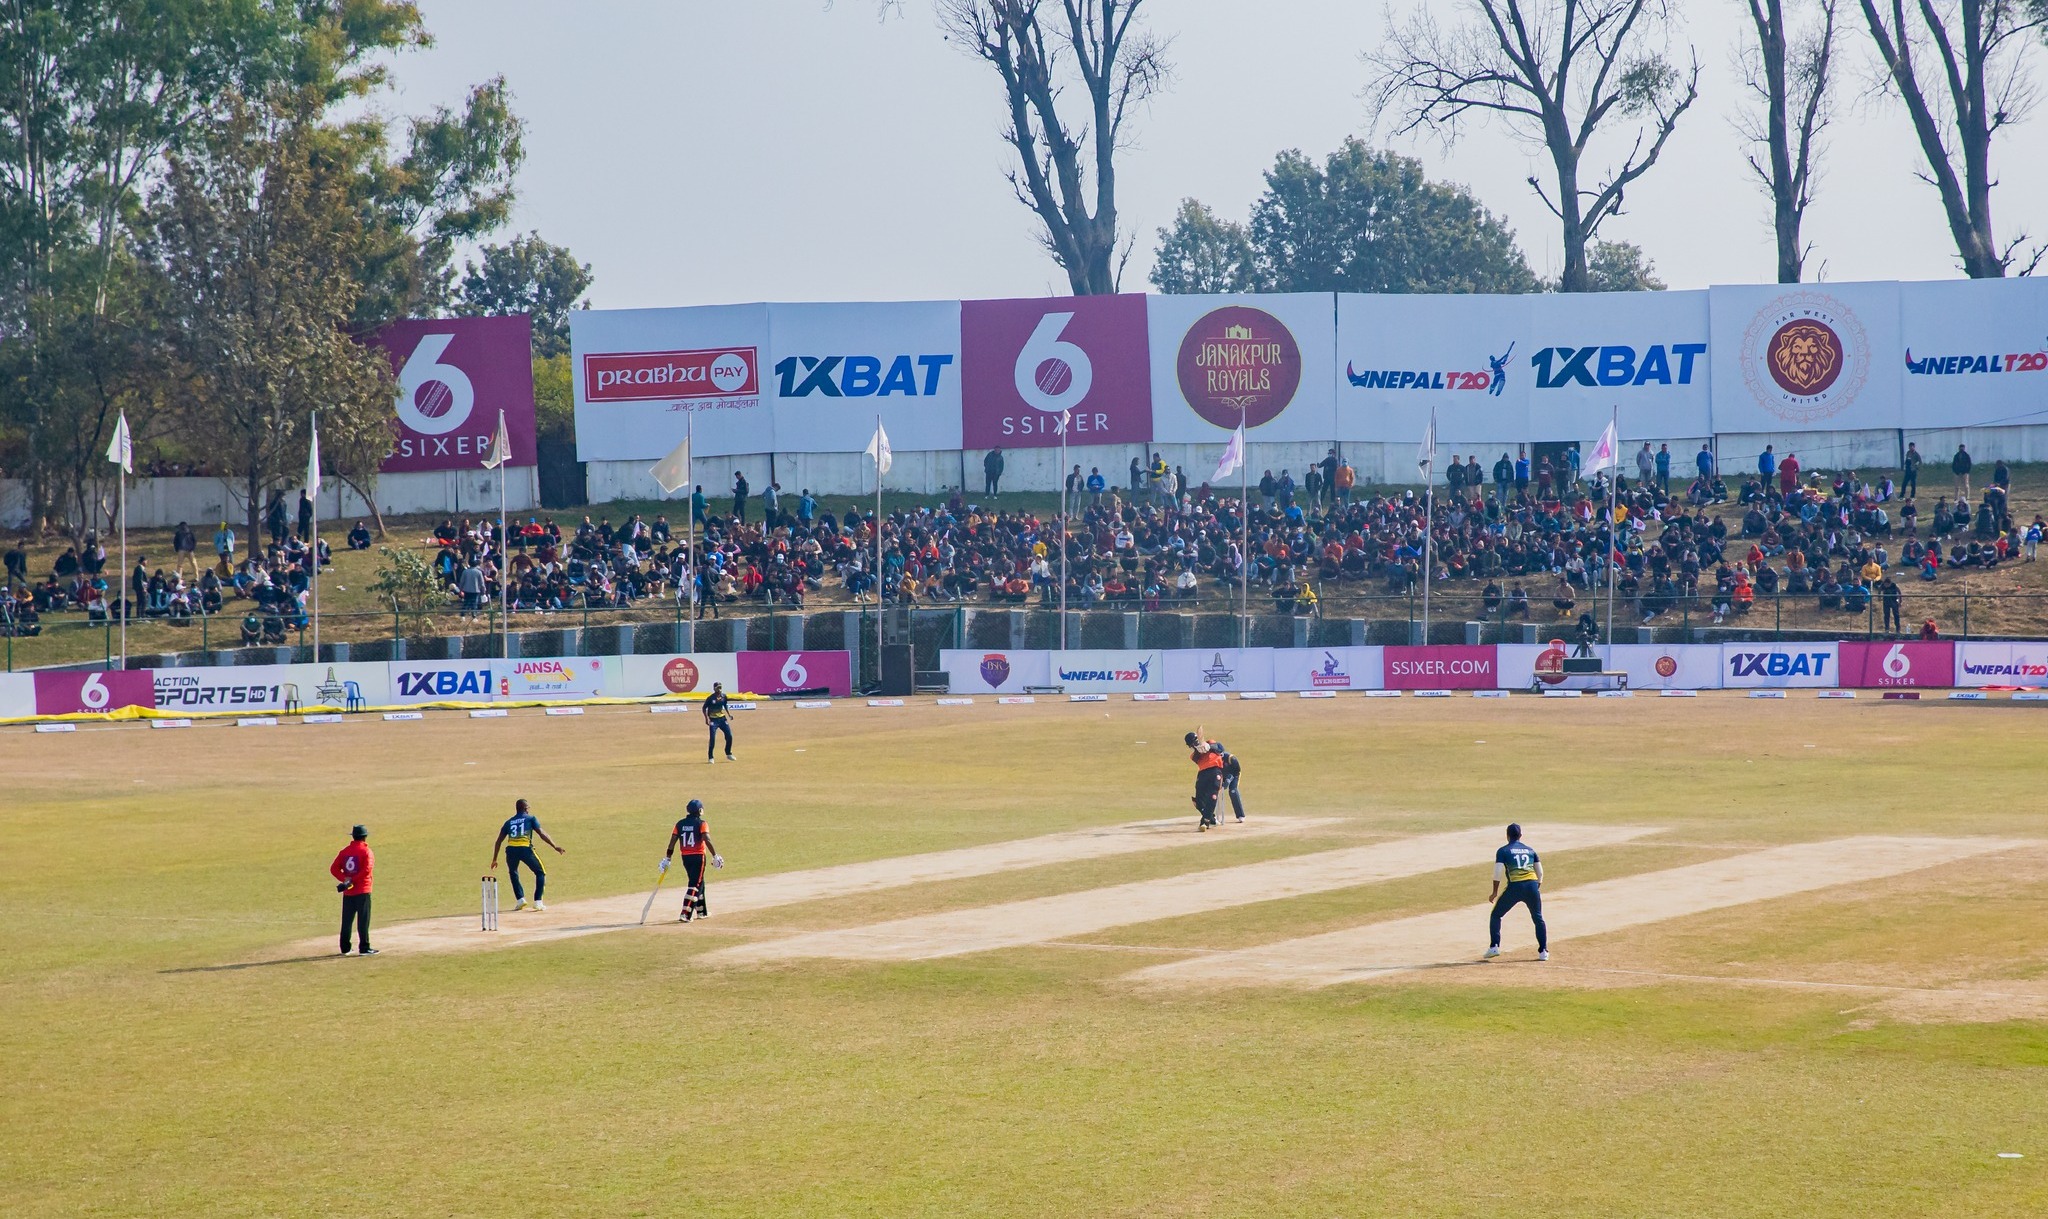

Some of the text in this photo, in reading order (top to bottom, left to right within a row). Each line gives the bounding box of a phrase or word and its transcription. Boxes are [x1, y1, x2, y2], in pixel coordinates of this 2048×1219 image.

[1775, 310, 1835, 326] FAR WEST
[1014, 311, 1093, 412] 6
[1195, 342, 1282, 368] JANAKPUR
[1926, 353, 2048, 375] NEPAL T20
[714, 366, 744, 378] PAY
[775, 354, 954, 397] 1XBAT
[1532, 343, 1707, 388] 1XBAT
[393, 333, 475, 435] 6
[1207, 368, 1271, 393] ROYALS
[1366, 370, 1491, 390] NEPAL T20
[1783, 394, 1828, 404] UNITED
[1002, 413, 1109, 435] SSIXER
[513, 661, 563, 675] JANSA
[1391, 660, 1490, 675] SSIXER.COM
[1730, 652, 1831, 677] 1XBAT
[1883, 643, 1911, 678] 6
[1976, 664, 2048, 676] NEPAL T20
[780, 654, 807, 688] 6
[1069, 670, 1140, 681] NEPAL T20
[80, 672, 110, 709] 6
[154, 676, 200, 687] ACTION
[154, 685, 280, 706] SPORTS HD 1
[510, 823, 525, 838] 31
[681, 832, 696, 848] 14
[345, 856, 355, 871] 6
[1513, 854, 1530, 869] 12
